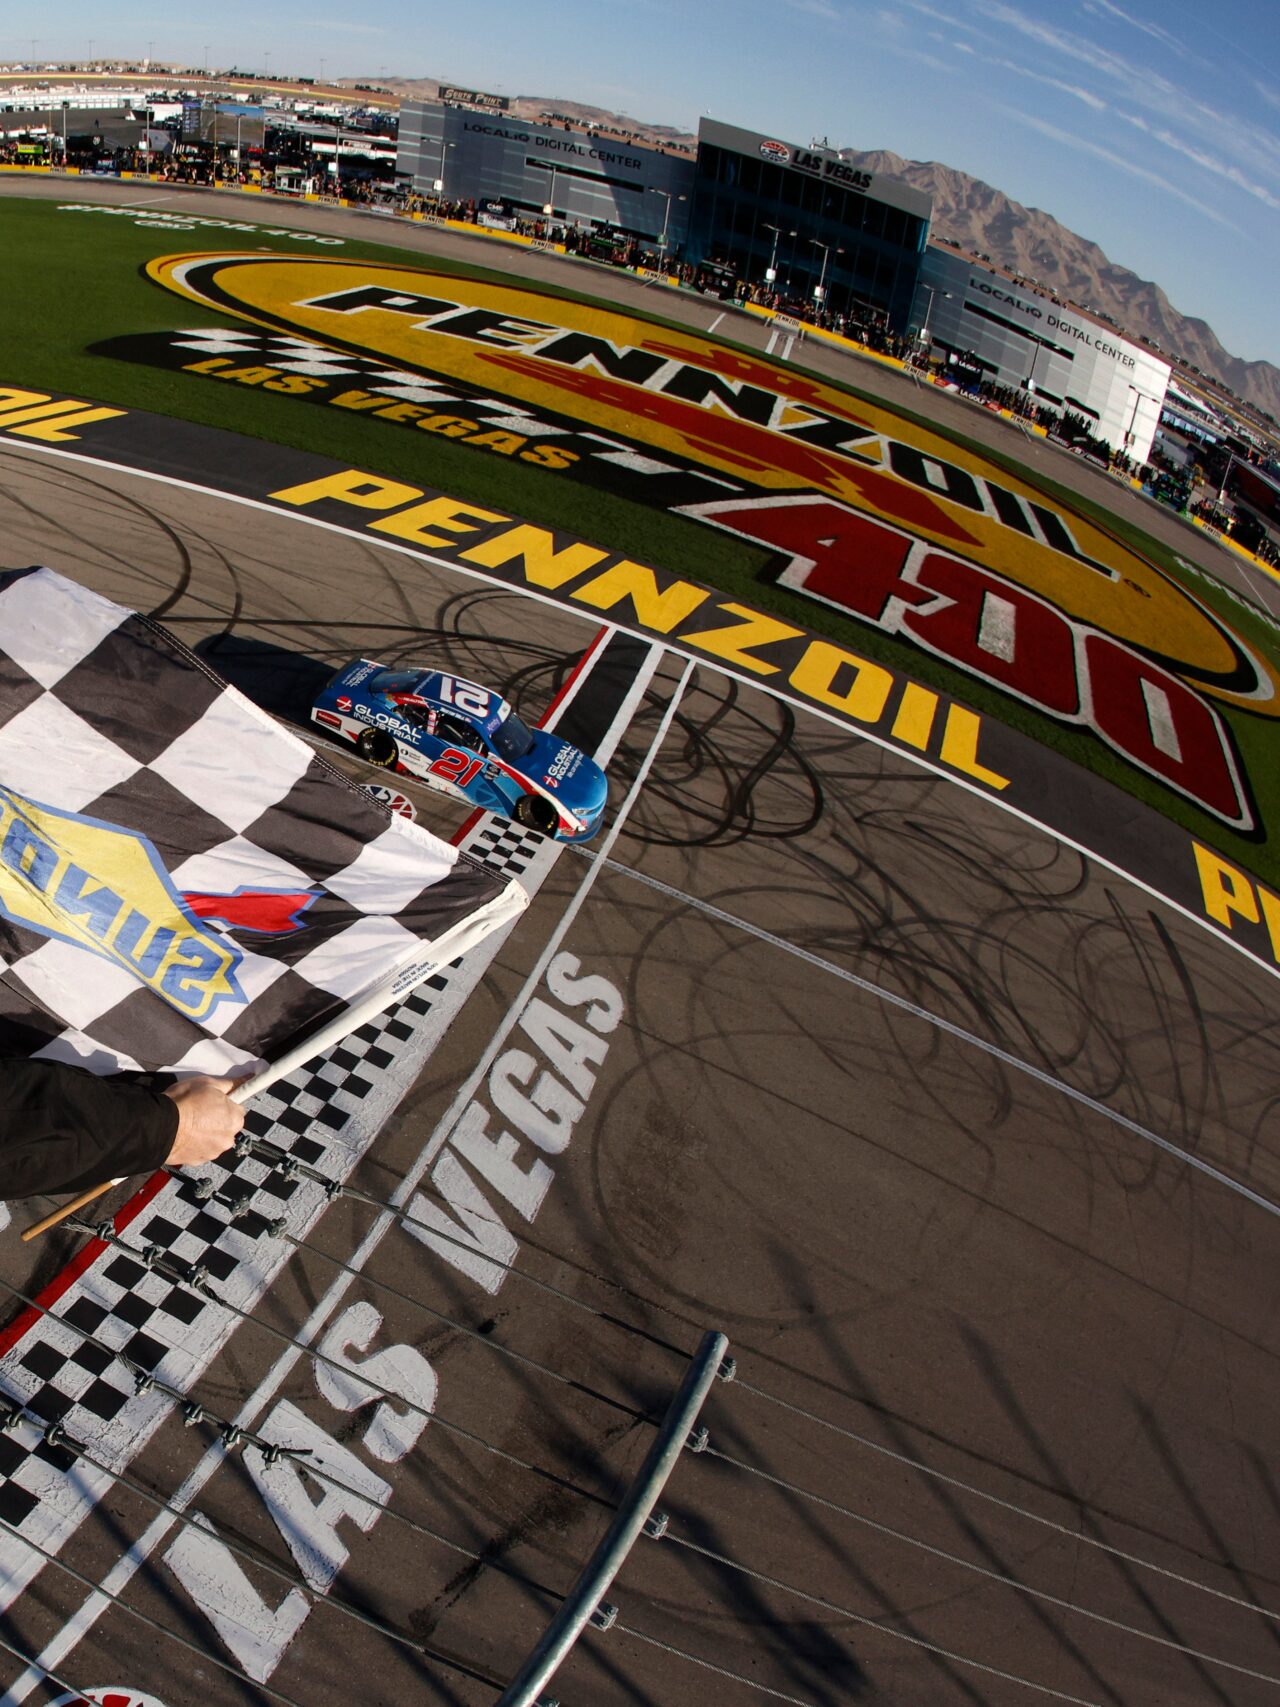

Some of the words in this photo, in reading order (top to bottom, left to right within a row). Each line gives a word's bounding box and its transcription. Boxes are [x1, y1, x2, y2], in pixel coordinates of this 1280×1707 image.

[535, 136, 586, 155] DIGITAL
[588, 148, 642, 170] CENTER
[794, 149, 821, 170] LAS
[825, 160, 873, 188] VEGAS
[531, 238, 556, 251] PENNZOIL
[644, 270, 669, 282] PENNZOIL
[775, 313, 800, 328] PENNZOIL
[1047, 314, 1092, 345] DIGITAL
[1094, 339, 1136, 369] CENTER
[182, 358, 329, 394] LAS
[328, 390, 581, 471] VEGAS
[290, 285, 1121, 583] PENNZOIL
[270, 468, 1011, 790] PENNZOIL
[669, 495, 1255, 832] 400
[440, 676, 489, 718] 21
[353, 711, 420, 745] INDUSTRIAL
[354, 703, 422, 739] GLOBAL
[428, 747, 485, 788] 21
[548, 744, 572, 776] GLOBAL
[399, 951, 627, 1297] VEGAS
[162, 1301, 438, 1684] LAS
